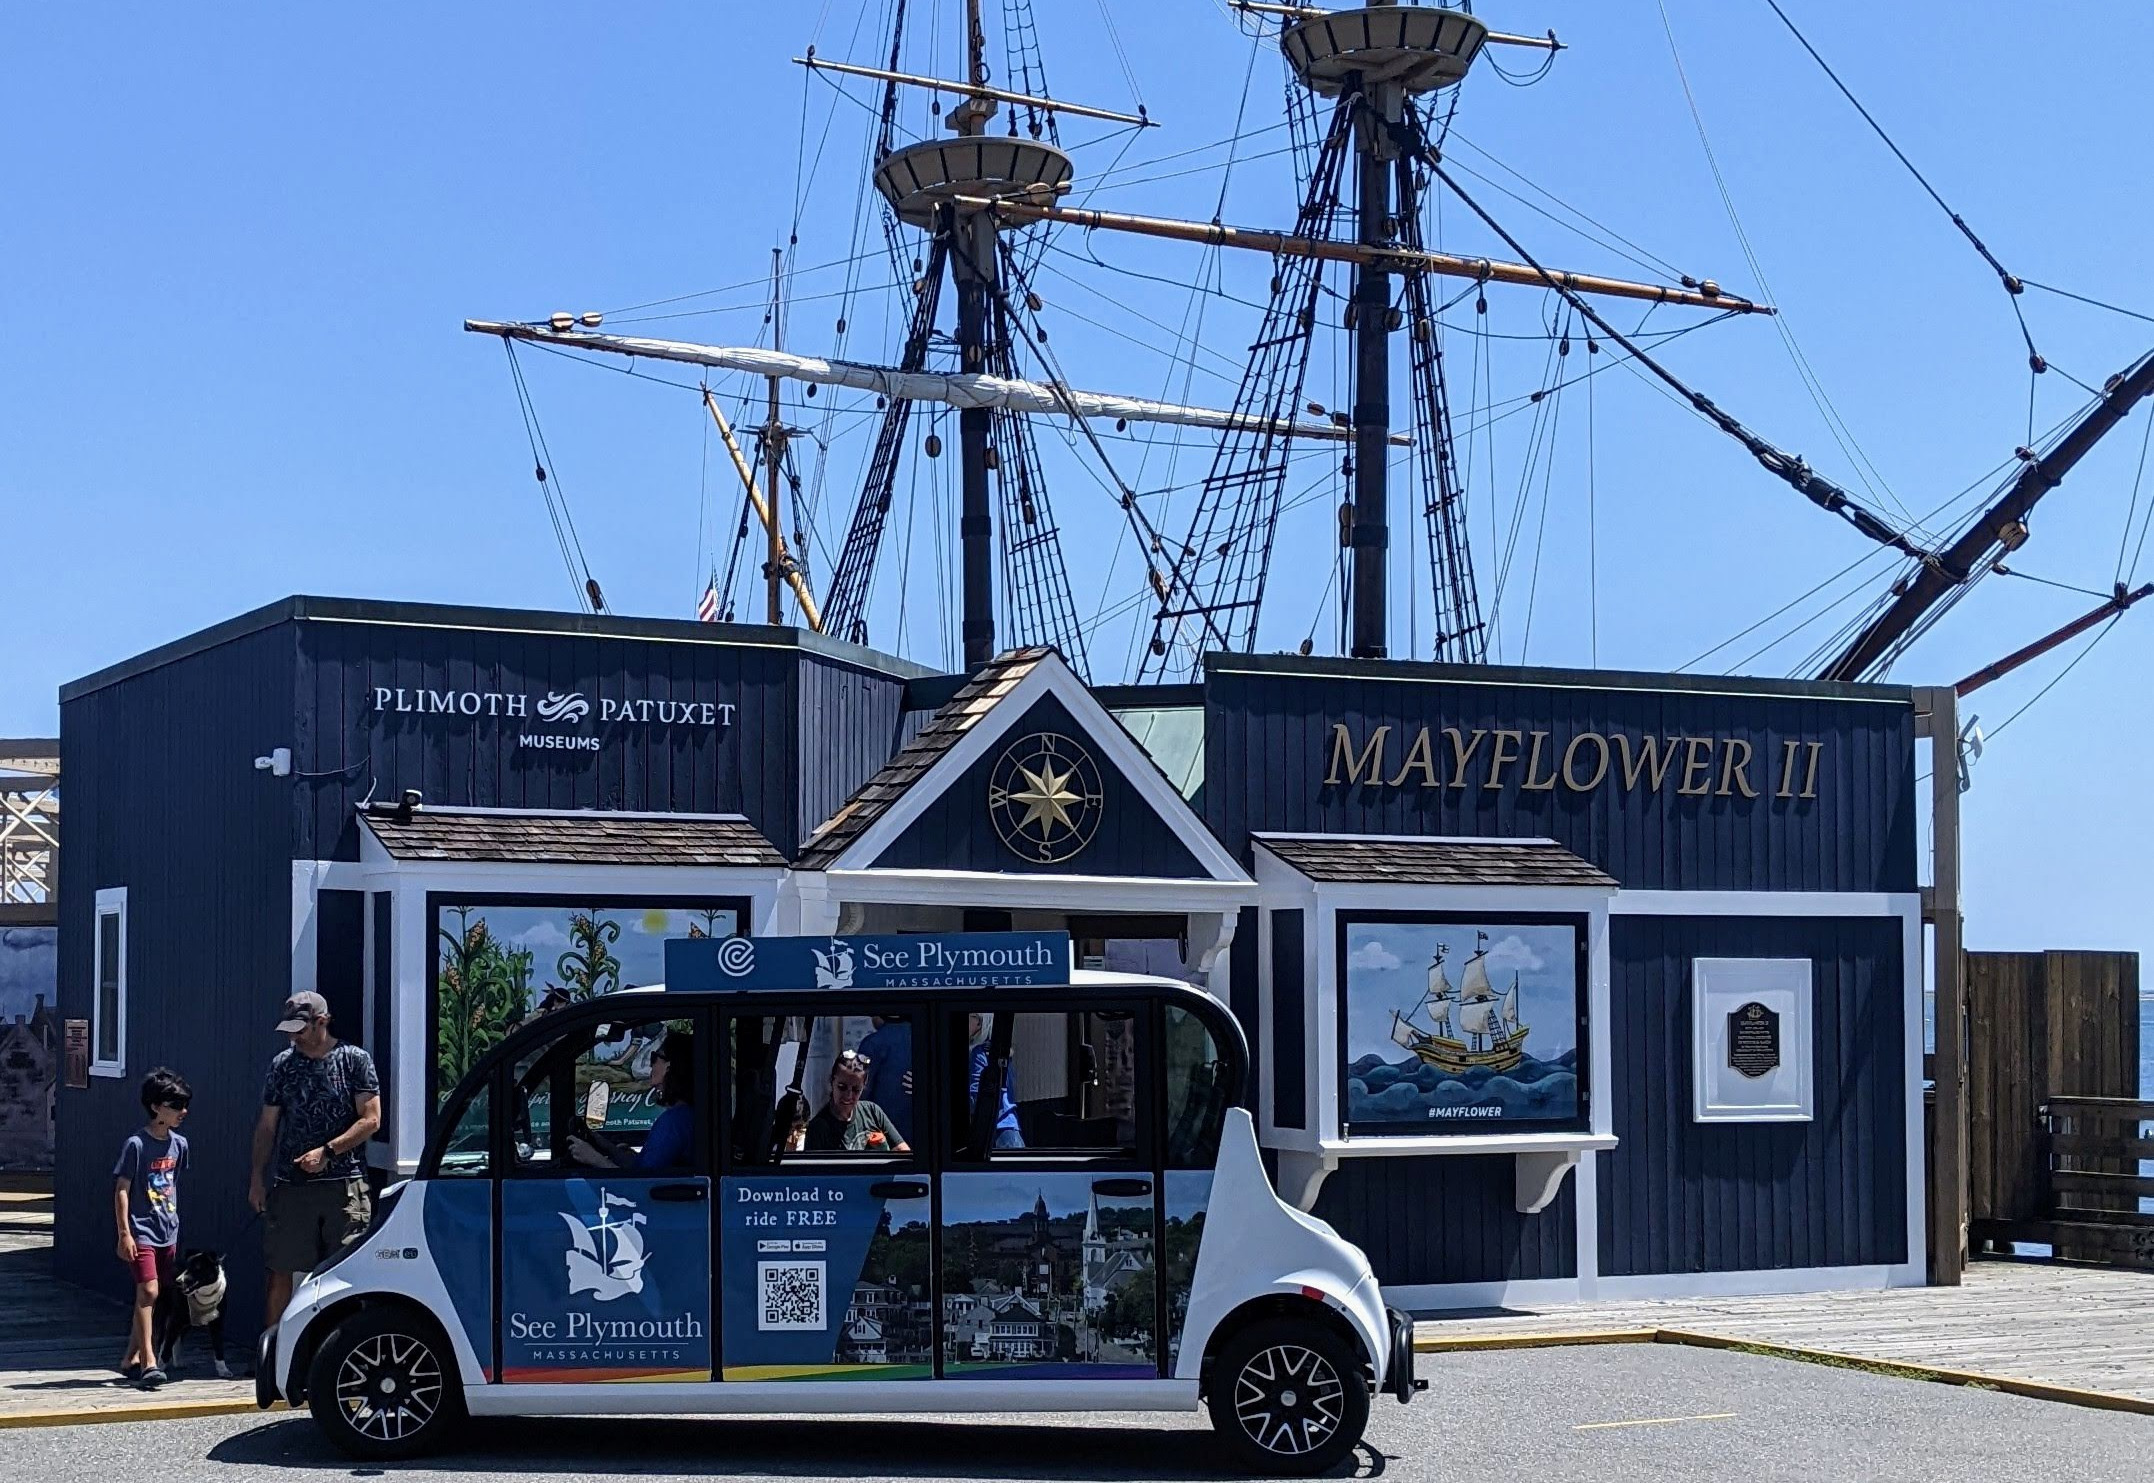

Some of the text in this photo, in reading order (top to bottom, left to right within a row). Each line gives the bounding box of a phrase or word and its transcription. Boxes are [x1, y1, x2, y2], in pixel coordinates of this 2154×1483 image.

[374, 687, 736, 726] PLIMOTH PATUXET
[519, 734, 600, 751] MUSEUMS
[1041, 734, 1056, 753] N
[1323, 723, 1824, 798] MAYFLOWER II
[1038, 842, 1052, 863] S
[863, 941, 1053, 976] See Plymouth
[885, 976, 1033, 988] MASSACHUSETTS
[1428, 1106, 1502, 1118] #MAYFLOWER
[737, 1187, 844, 1202] Download to
[745, 1210, 837, 1226] ride FREE
[510, 1311, 703, 1346] See Plymouth
[533, 1350, 680, 1360] MASSACHUSETTS
